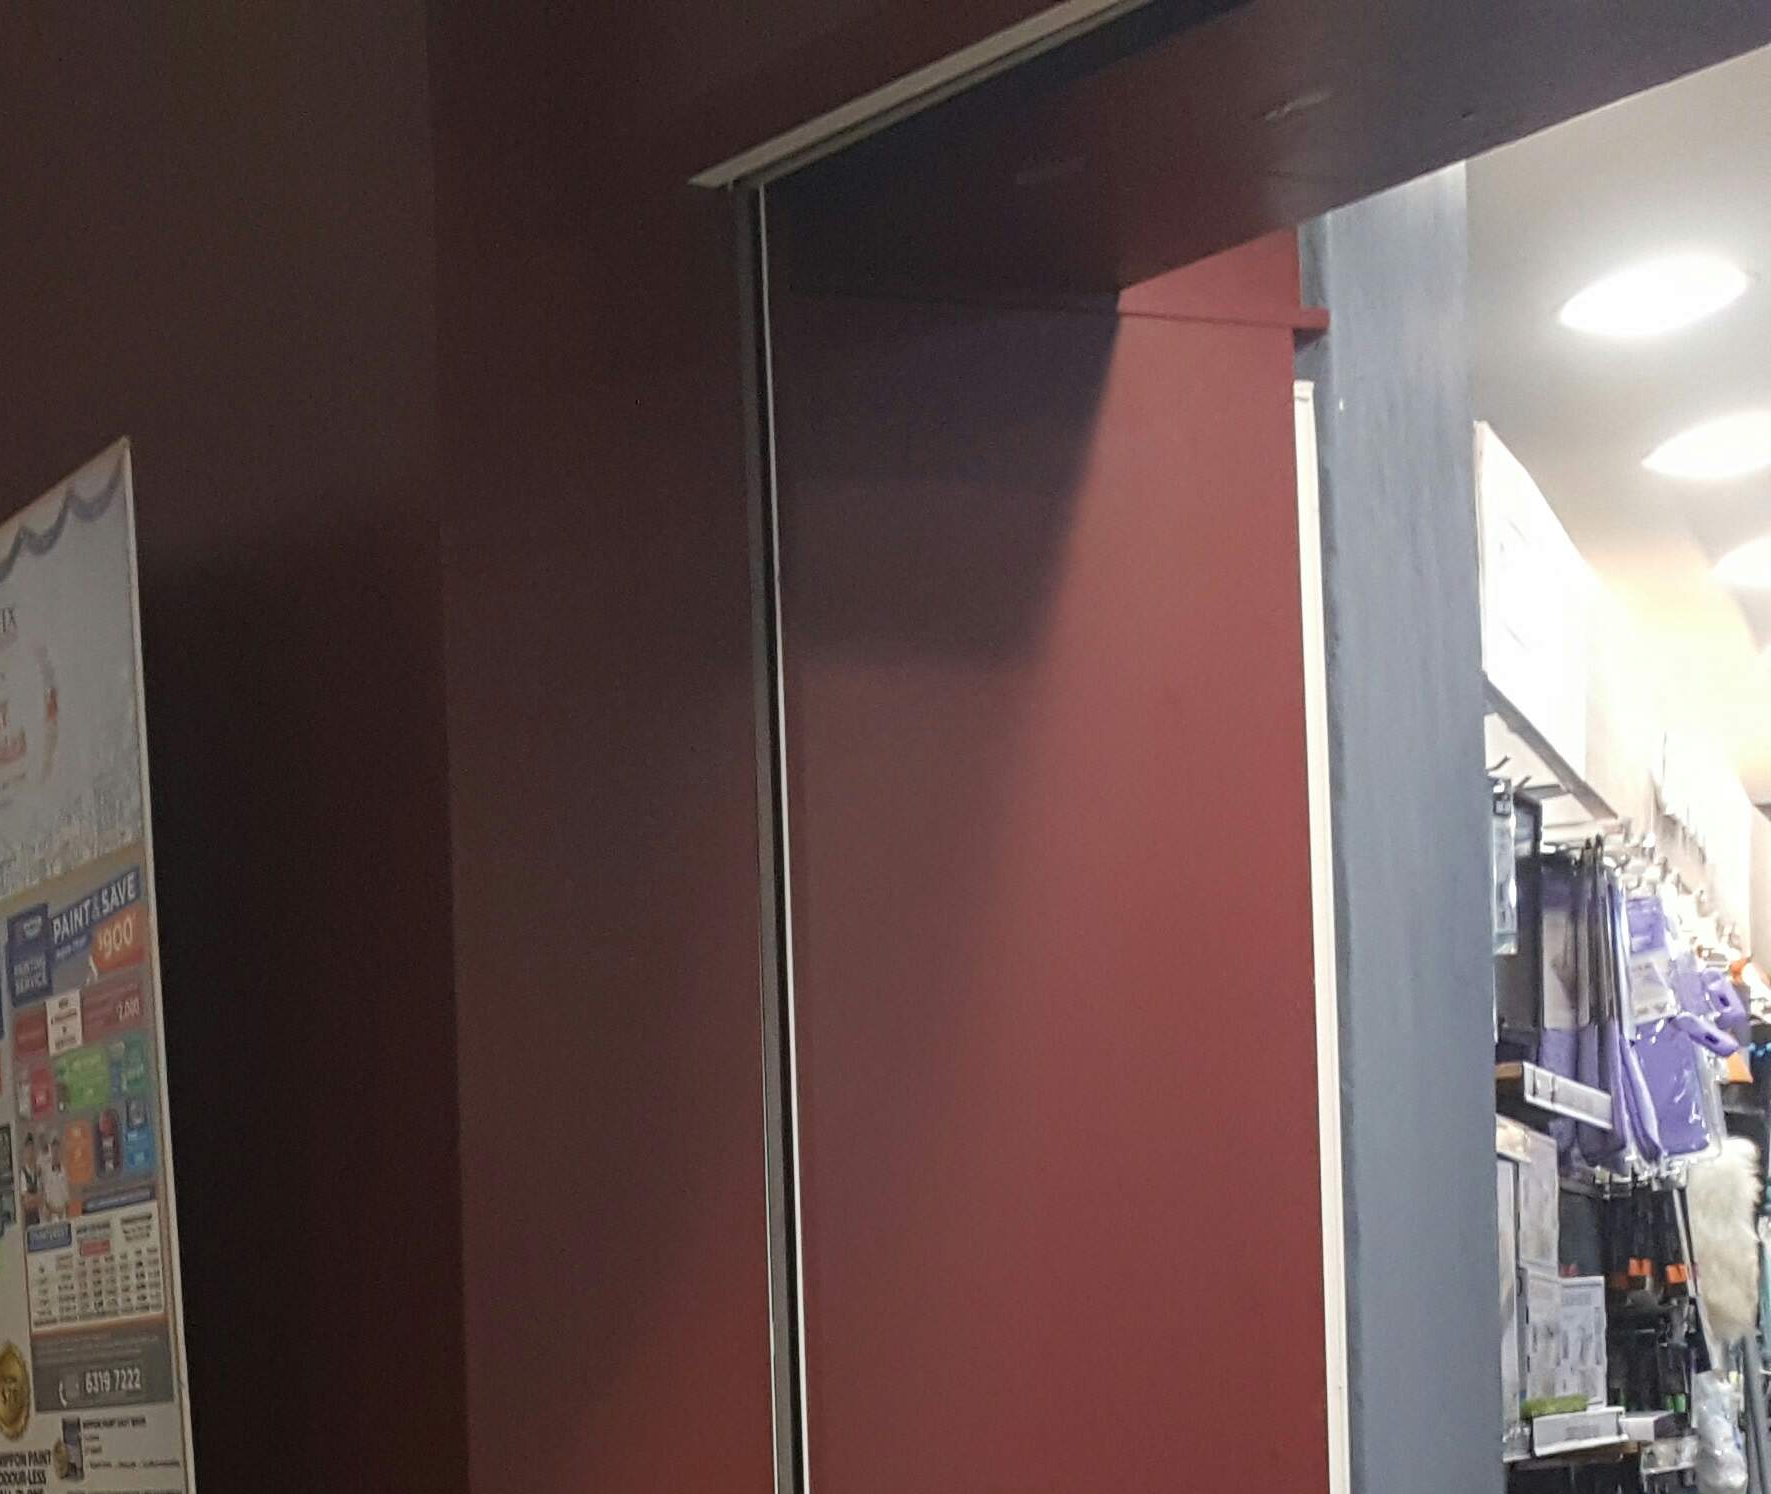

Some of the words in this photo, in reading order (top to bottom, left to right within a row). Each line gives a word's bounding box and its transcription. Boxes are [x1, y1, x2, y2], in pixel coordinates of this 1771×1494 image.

[51, 899, 90, 944] PAINT
[101, 870, 138, 915] SAVE
[114, 1367, 142, 1391] 7222
[27, 1450, 51, 1467] PAINT
